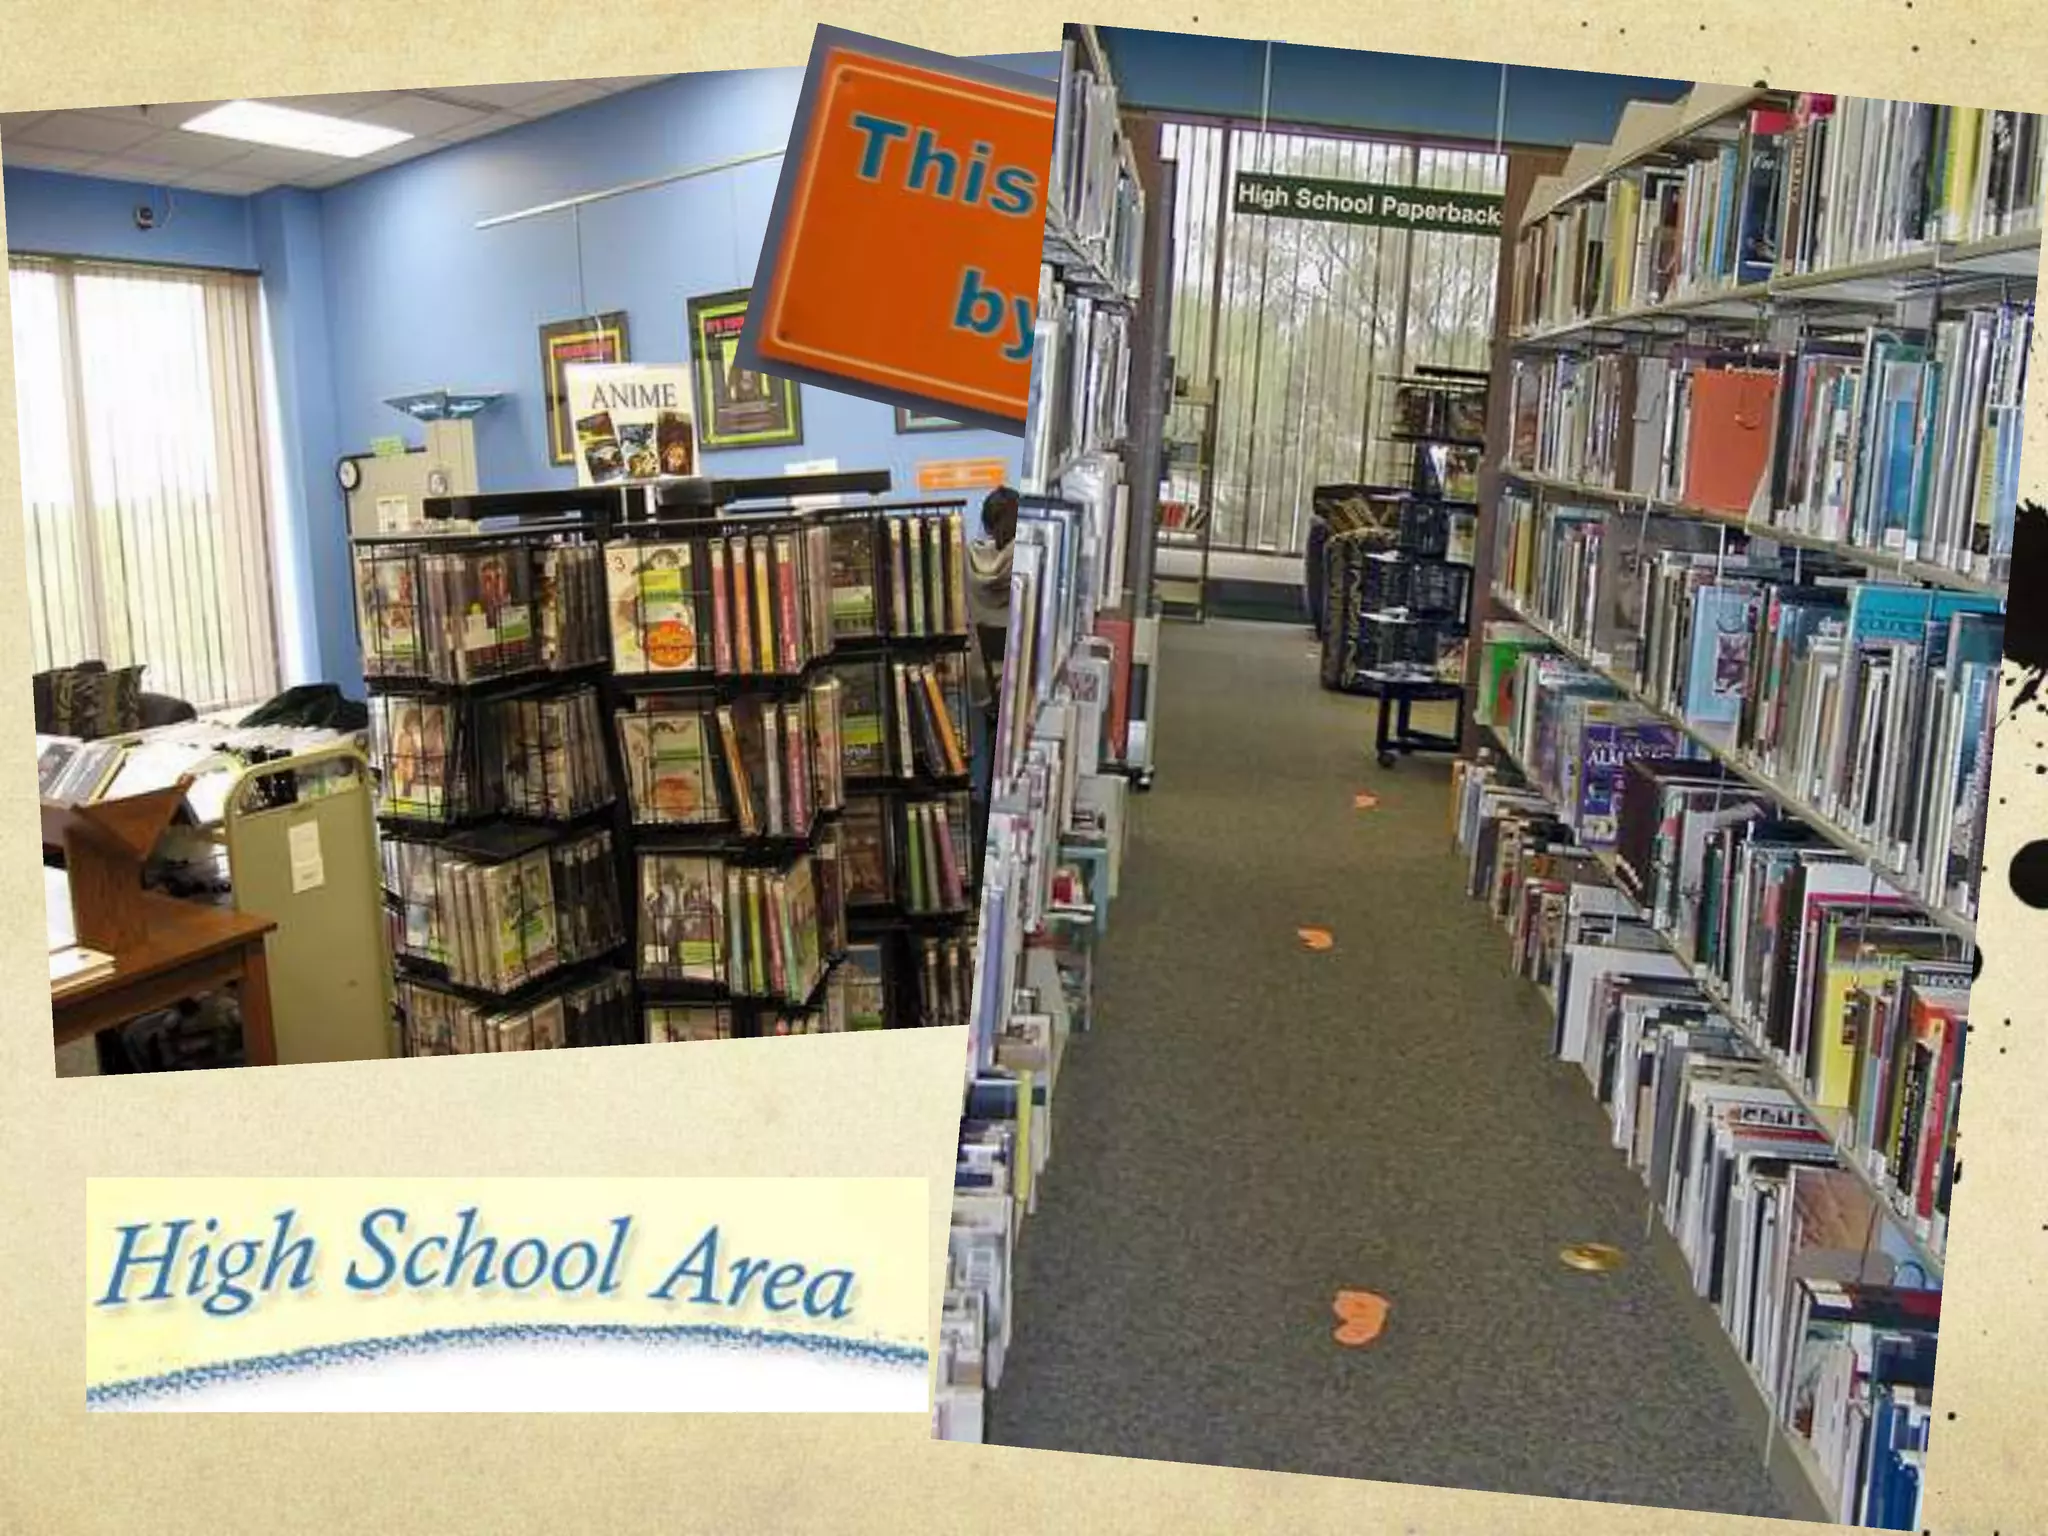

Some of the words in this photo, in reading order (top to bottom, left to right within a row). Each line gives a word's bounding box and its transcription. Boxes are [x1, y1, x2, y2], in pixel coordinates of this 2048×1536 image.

[852, 112, 1037, 215] This
[1237, 182, 1289, 209] High
[1295, 187, 1374, 215] School
[952, 268, 1036, 359] by
[591, 382, 678, 410] ANIME
[97, 1208, 316, 1317] High
[345, 1206, 633, 1295] School
[647, 1223, 856, 1320] Area
